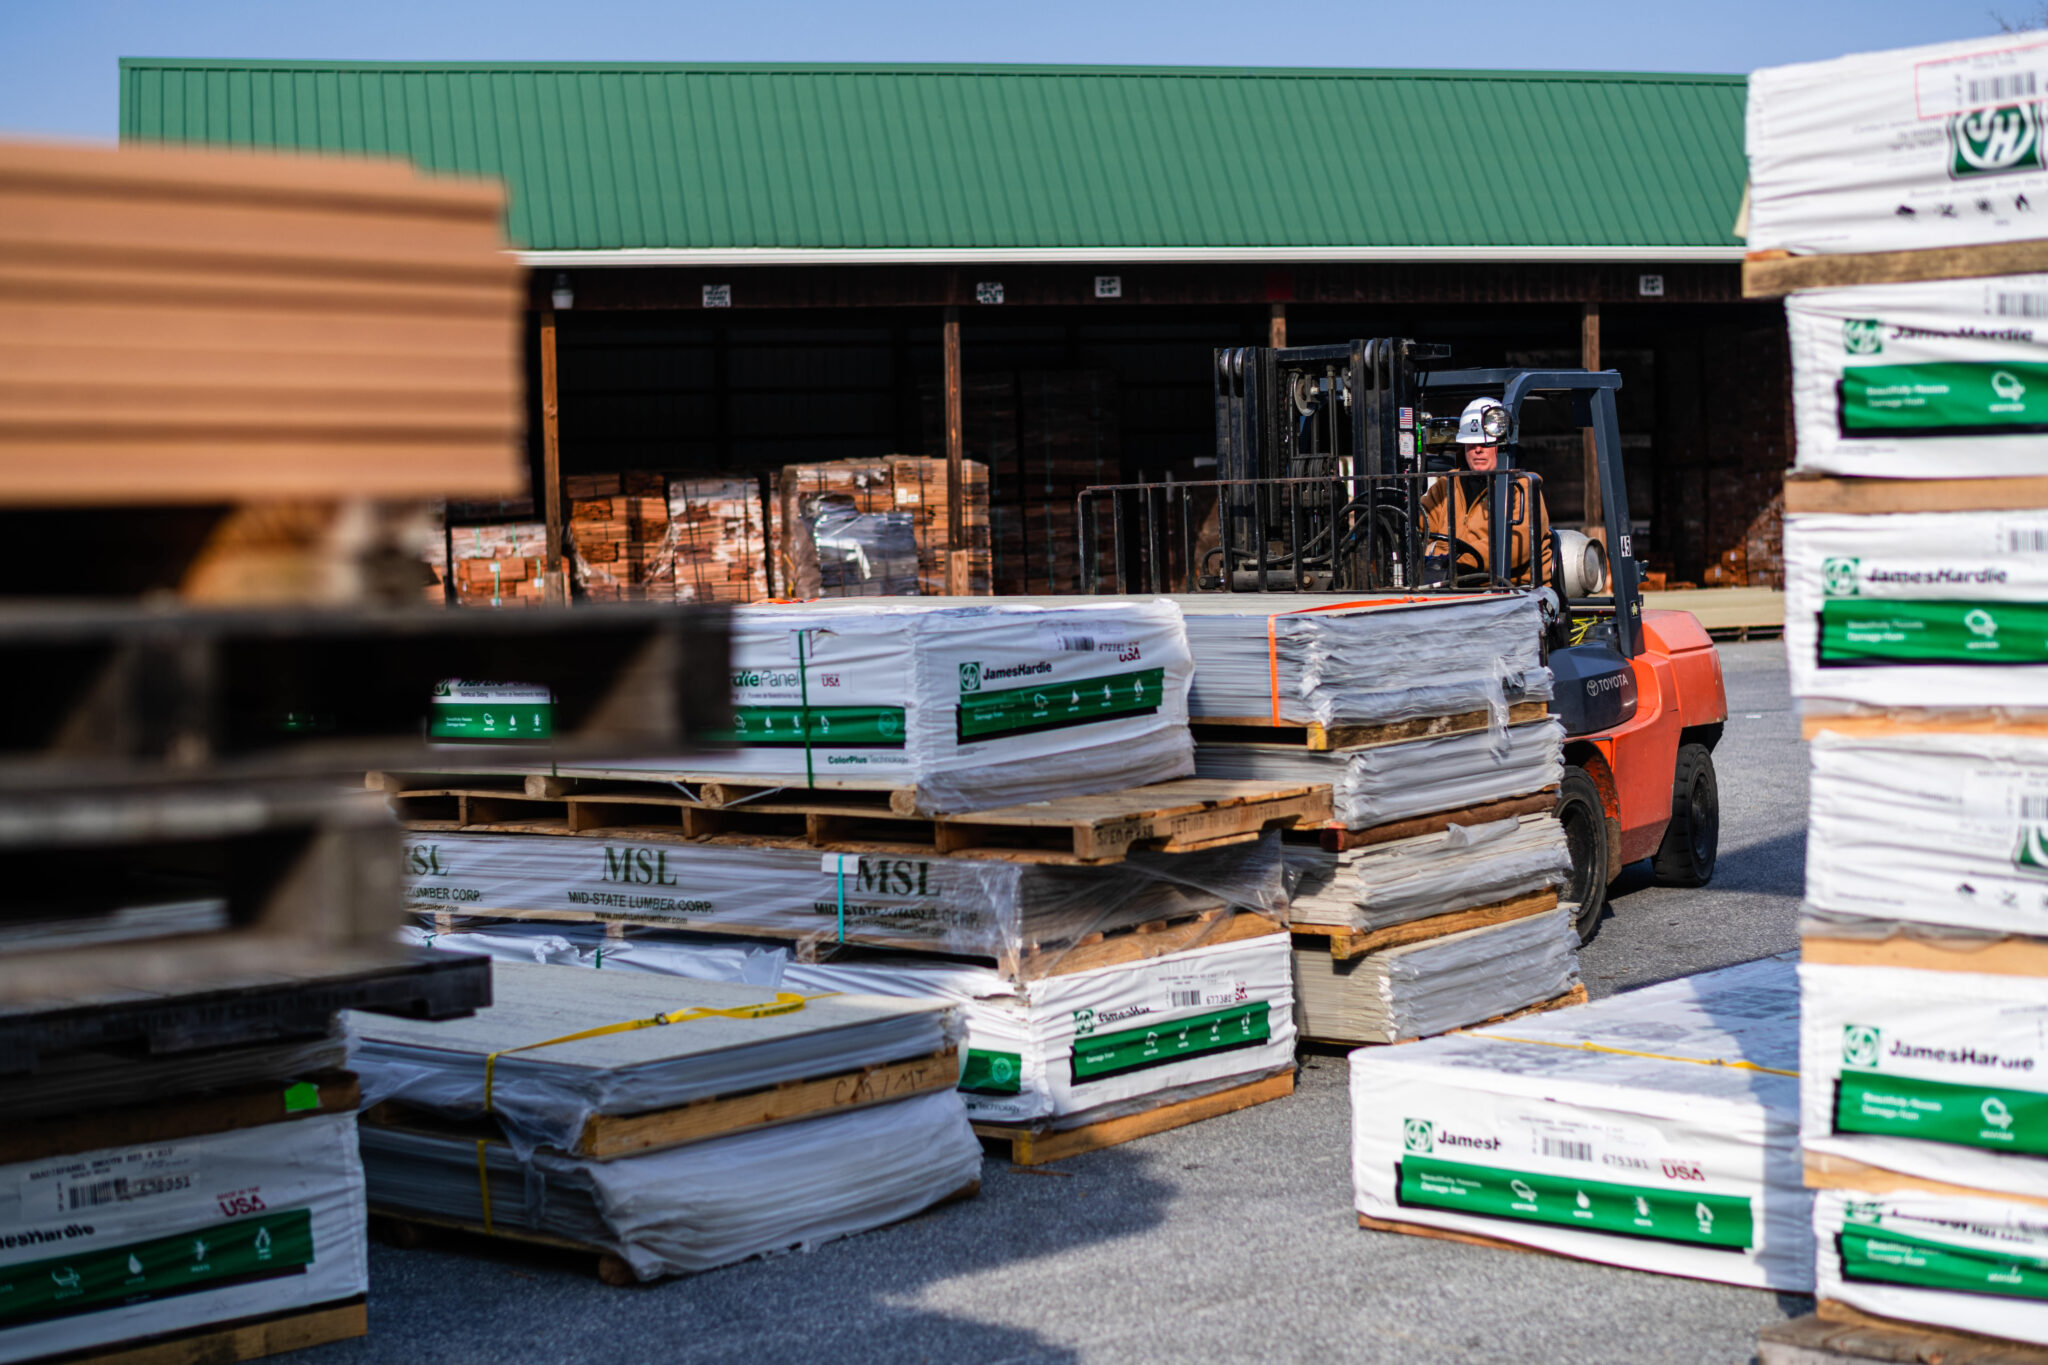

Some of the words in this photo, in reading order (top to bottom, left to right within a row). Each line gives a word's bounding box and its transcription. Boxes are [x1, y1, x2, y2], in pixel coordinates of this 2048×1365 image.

[983, 661, 1052, 681] JamesHardie
[821, 677, 840, 687] USA
[1597, 674, 1629, 692] TOYOTA
[828, 756, 867, 765] ColorPlus
[601, 846, 678, 886] MSL
[855, 860, 941, 897] MSL
[452, 888, 483, 902] CORP.
[568, 891, 626, 908] MID-STATE
[628, 895, 676, 911] LUMBER
[678, 899, 715, 914] CORP.
[1602, 1153, 1650, 1170] 675381
[1661, 1164, 1706, 1182] USA
[220, 1195, 266, 1217] USA
